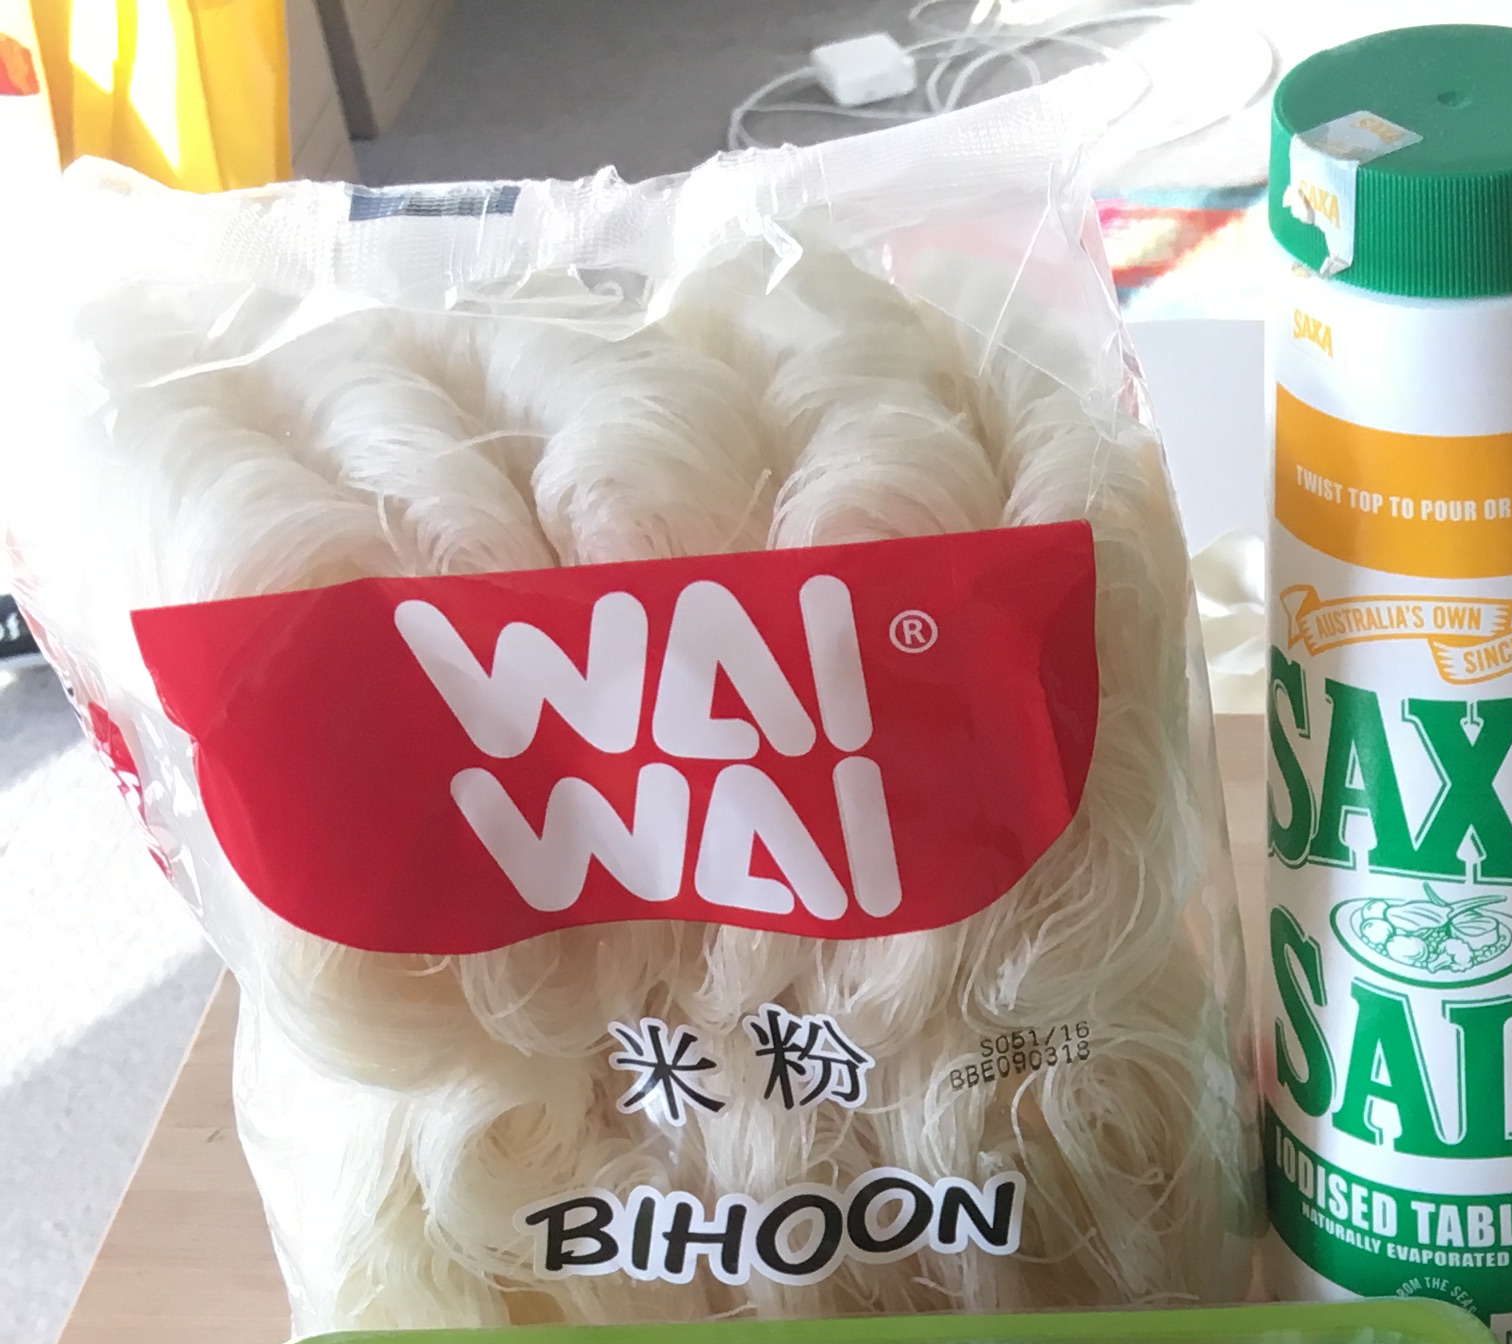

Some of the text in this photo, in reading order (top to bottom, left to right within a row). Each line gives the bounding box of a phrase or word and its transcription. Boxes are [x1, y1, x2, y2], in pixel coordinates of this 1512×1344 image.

[1293, 308, 1334, 359] SAXA
[1297, 464, 1343, 503] TWIST
[1348, 487, 1383, 514] TOP
[1389, 496, 1414, 519] TO
[1421, 499, 1477, 522] POUR
[1484, 497, 1511, 520] OR
[1315, 606, 1481, 639] AUSTRALIA'S OWN
[394, 574, 873, 760] WAI
[449, 755, 902, 920] WAI
[615, 1008, 868, 1121] 米粉
[949, 1041, 1092, 1091] BBE090318
[980, 1021, 1091, 1058] S051/16
[1275, 1123, 1397, 1238] IODISED
[526, 1176, 1015, 1275] BIHOON
[1301, 1202, 1381, 1254] NATURALLY
[1387, 1243, 1509, 1267] EVAPORATED
[1424, 1276, 1449, 1291] THE
